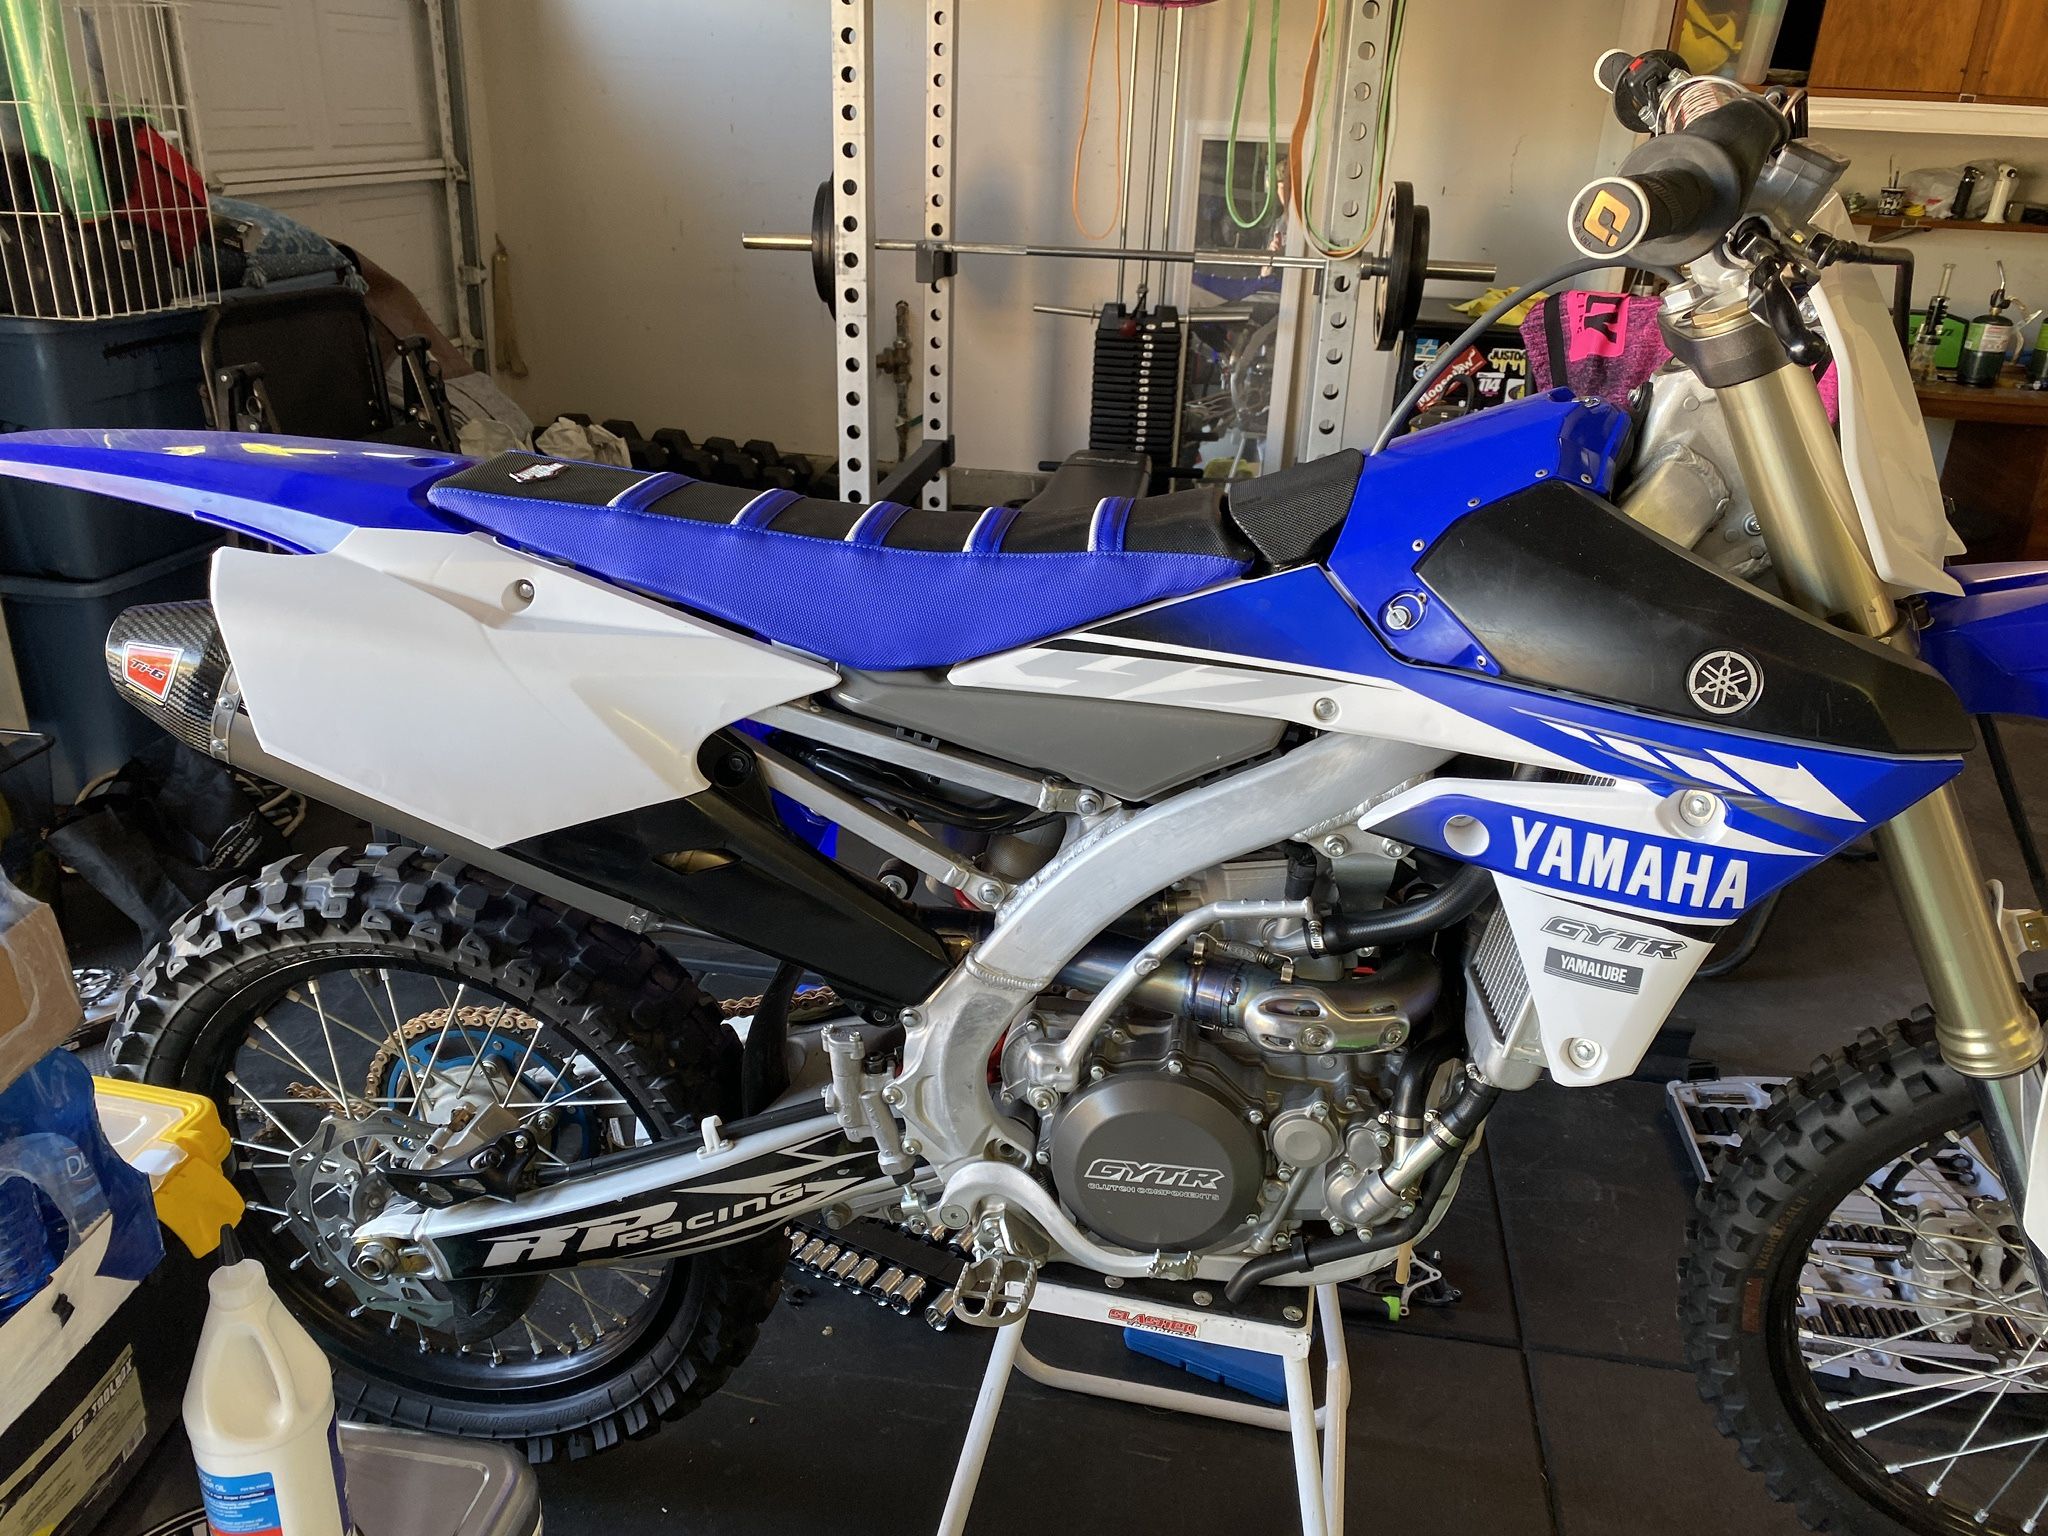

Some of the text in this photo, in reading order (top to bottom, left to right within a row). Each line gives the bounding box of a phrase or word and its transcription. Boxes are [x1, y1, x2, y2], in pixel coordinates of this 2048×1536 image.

[130, 658, 167, 680] Ti-6
[1511, 815, 1749, 909] YAMAHA
[1540, 915, 1688, 960] GYTR
[1560, 954, 1628, 984] YAMALUBE
[1084, 1158, 1226, 1190] GYTR
[1087, 1182, 1220, 1201] CLUTCH COMPONENTS
